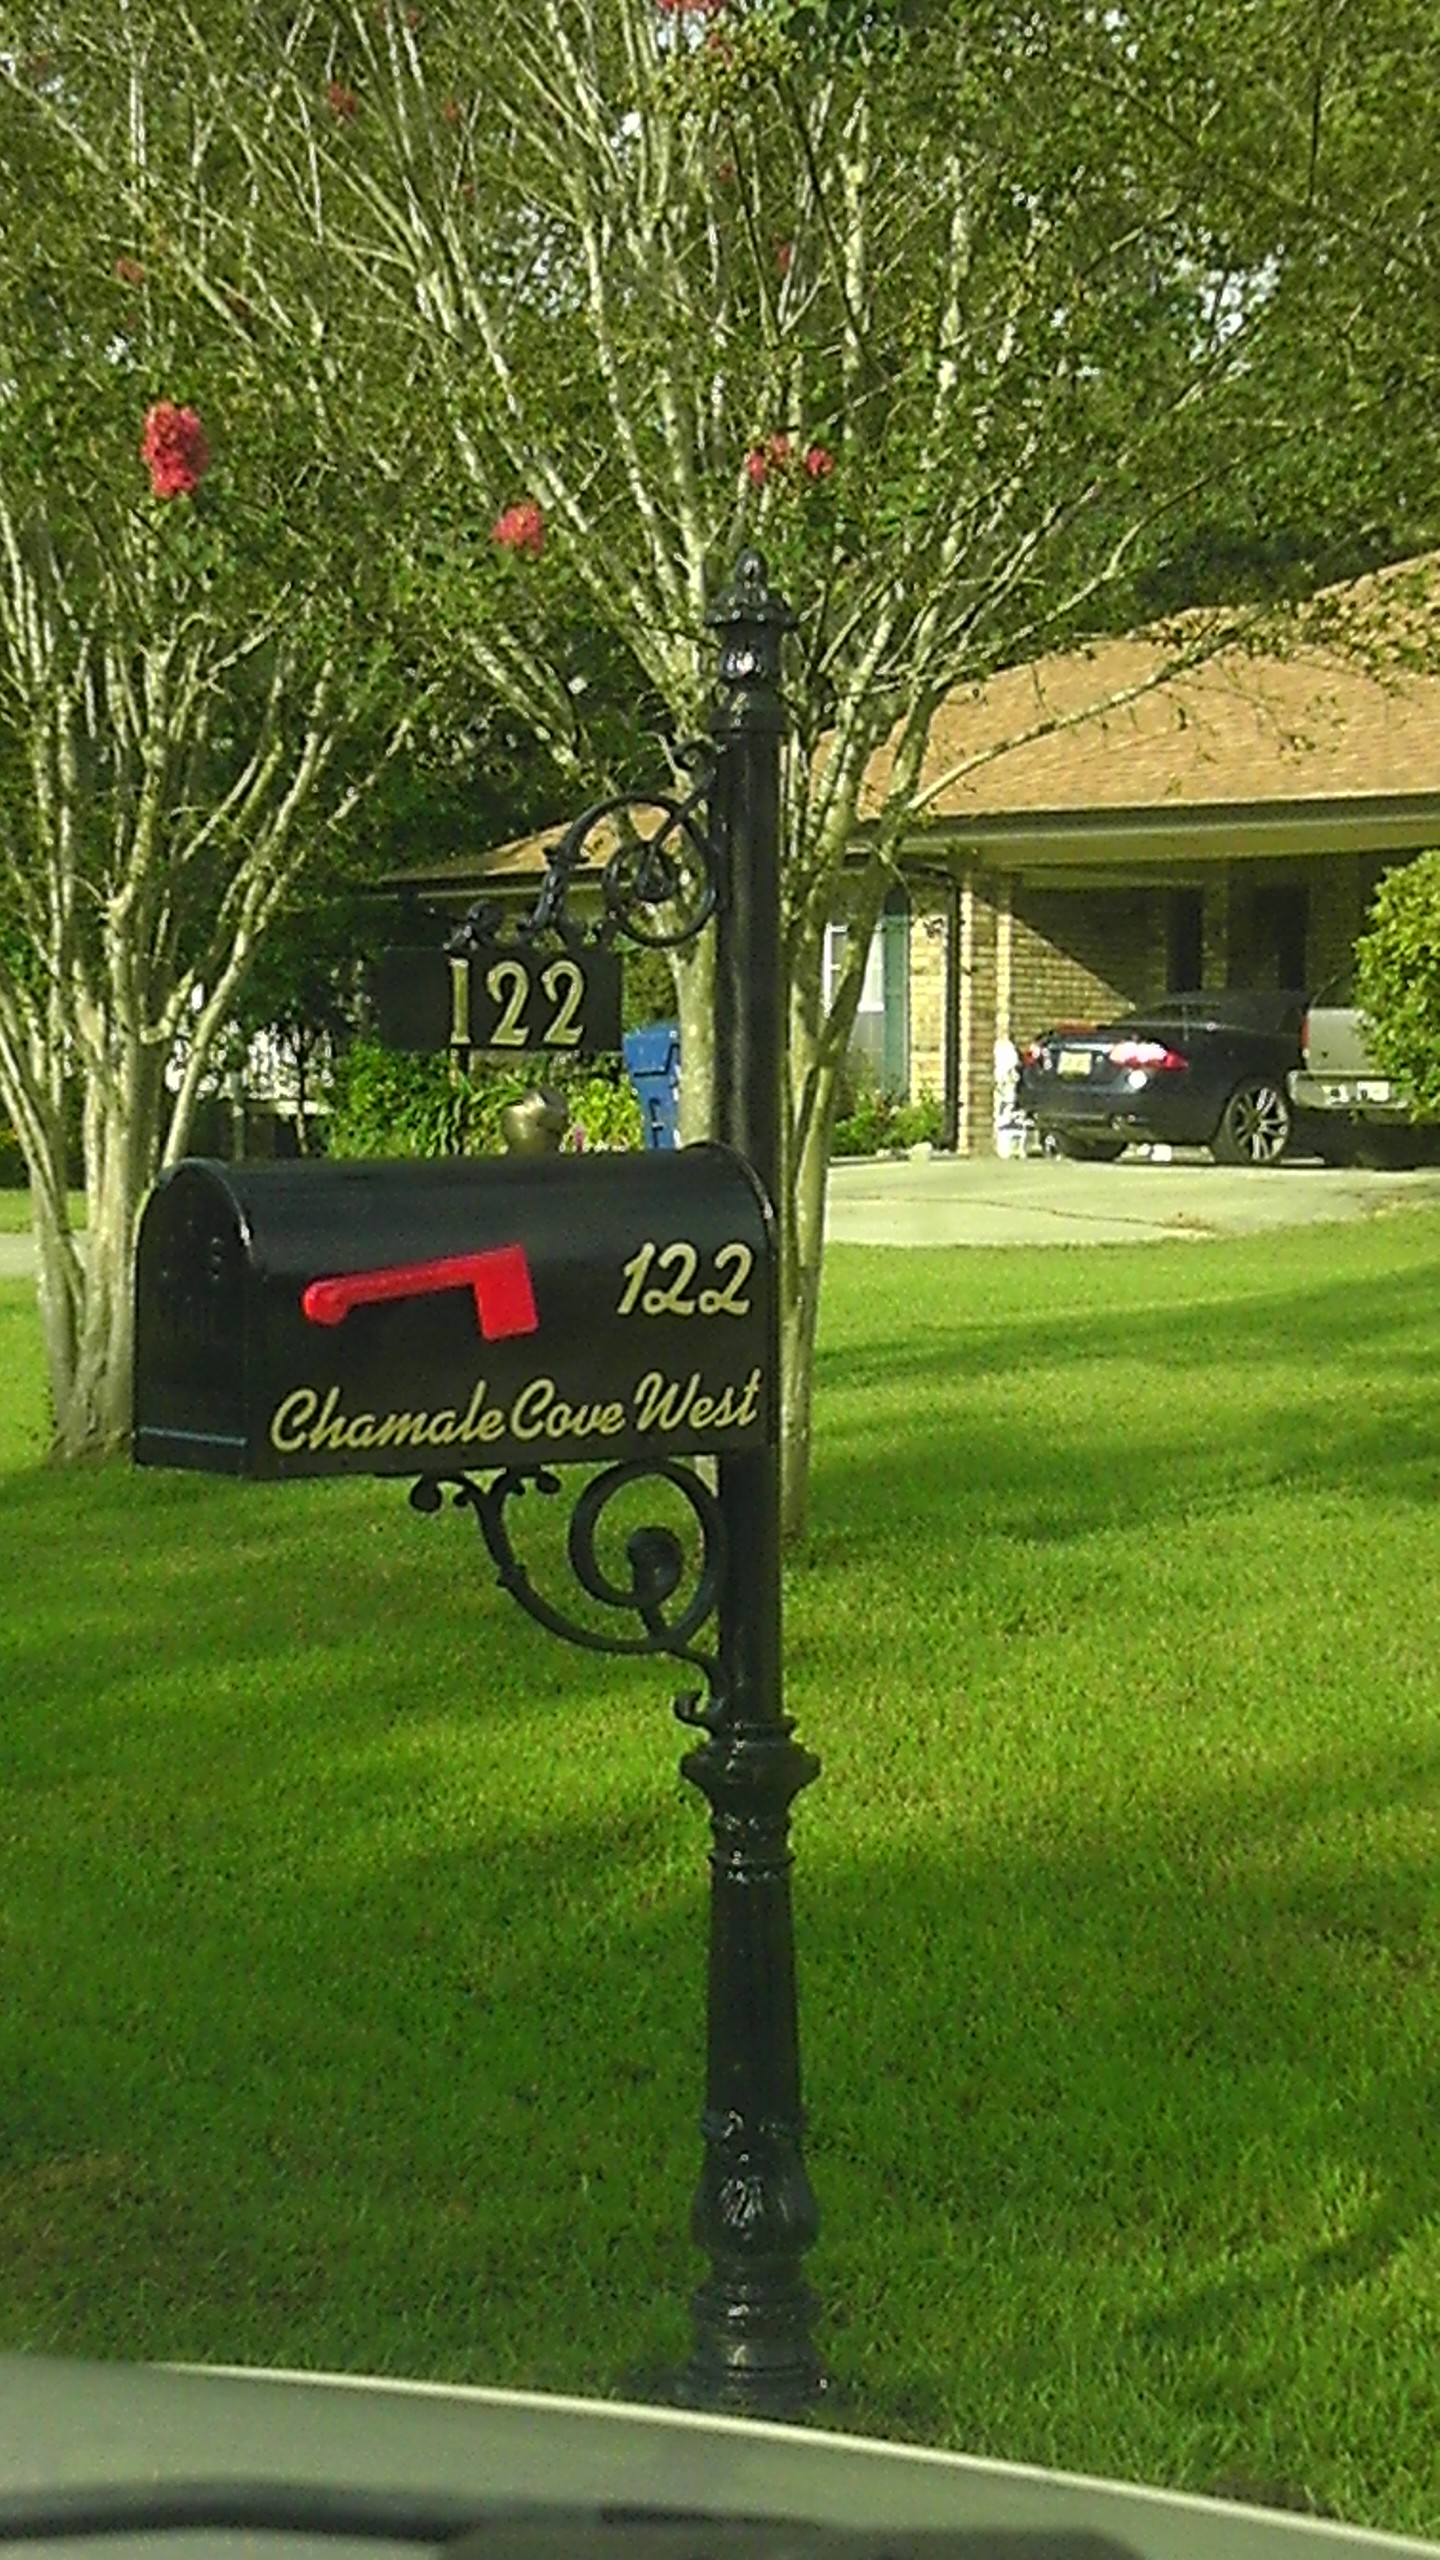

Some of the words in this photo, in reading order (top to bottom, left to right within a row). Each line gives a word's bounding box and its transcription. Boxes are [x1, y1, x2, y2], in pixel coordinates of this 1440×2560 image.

[448, 957, 586, 1047] 122
[616, 1240, 755, 1317] 122
[270, 1380, 503, 1452] Chamale
[510, 1378, 625, 1441] Cove
[634, 1368, 763, 1431] West
